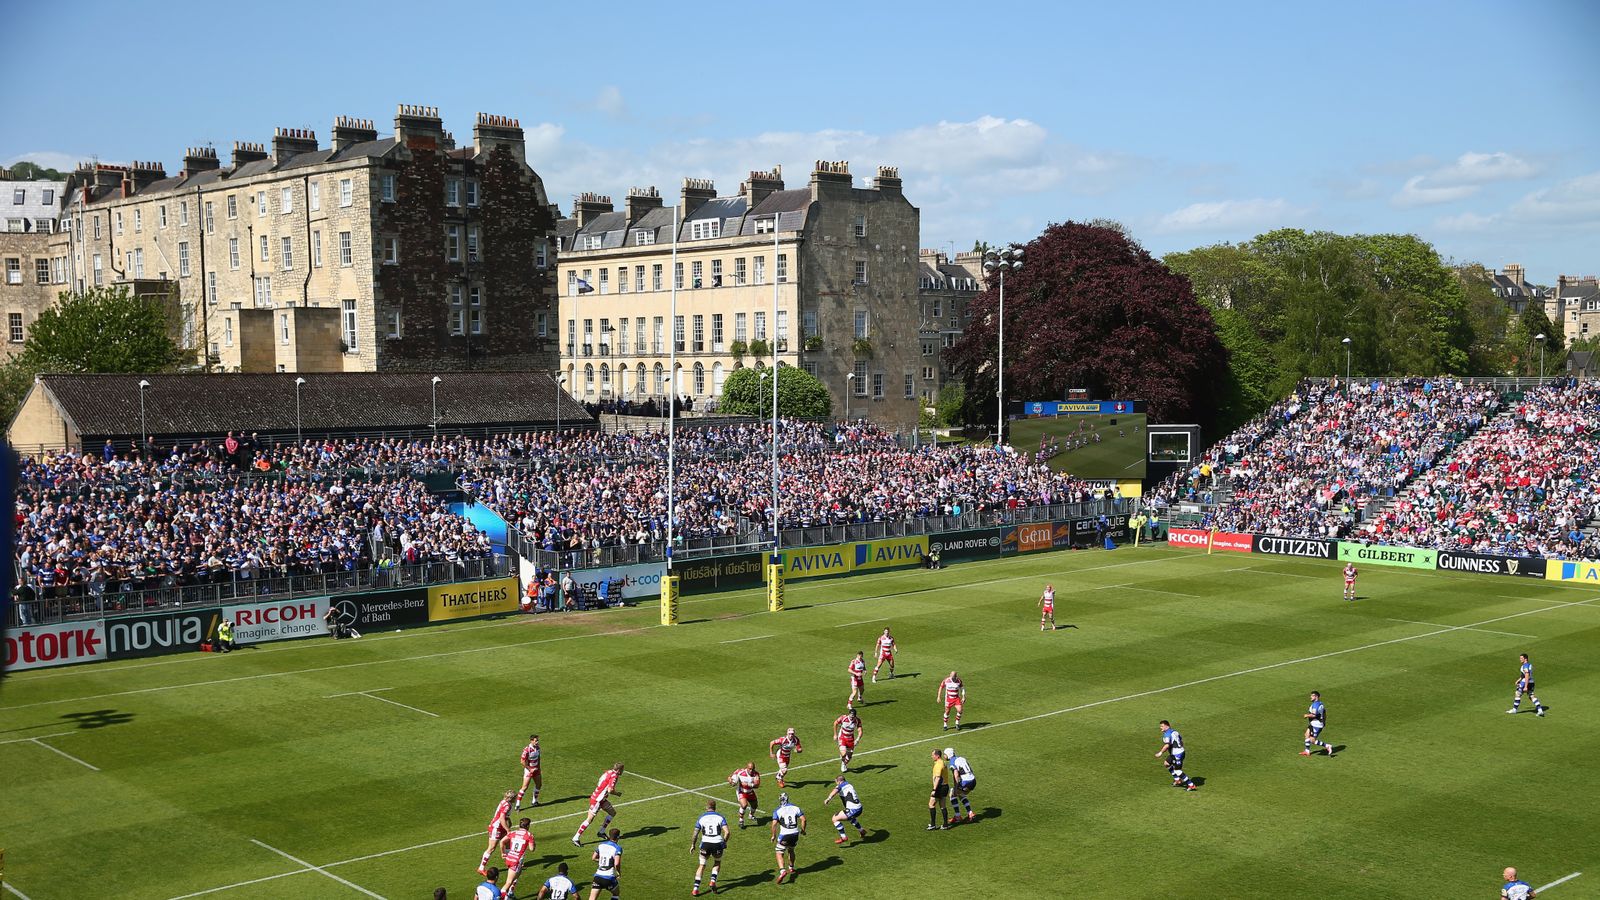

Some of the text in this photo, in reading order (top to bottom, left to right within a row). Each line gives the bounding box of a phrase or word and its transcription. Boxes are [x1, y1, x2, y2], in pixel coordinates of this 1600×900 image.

[1019, 527, 1051, 544] Gem
[1168, 532, 1208, 545] RICOH
[875, 543, 923, 562] AVIVA
[944, 538, 987, 551] LAND ROVER
[1258, 537, 1331, 558] CITIZEN
[791, 552, 844, 572] AVIVA
[1357, 548, 1415, 563] GILBERT
[1438, 553, 1501, 573] GUINNESS
[441, 587, 507, 607] THATCHERS
[235, 603, 317, 627] RICOH
[361, 599, 425, 614] Mercedes-Benz
[362, 612, 391, 624] of Bath
[110, 616, 202, 652] novia
[236, 627, 279, 639] imagine.
[281, 623, 319, 635] change.
[708, 825, 714, 835] 5
